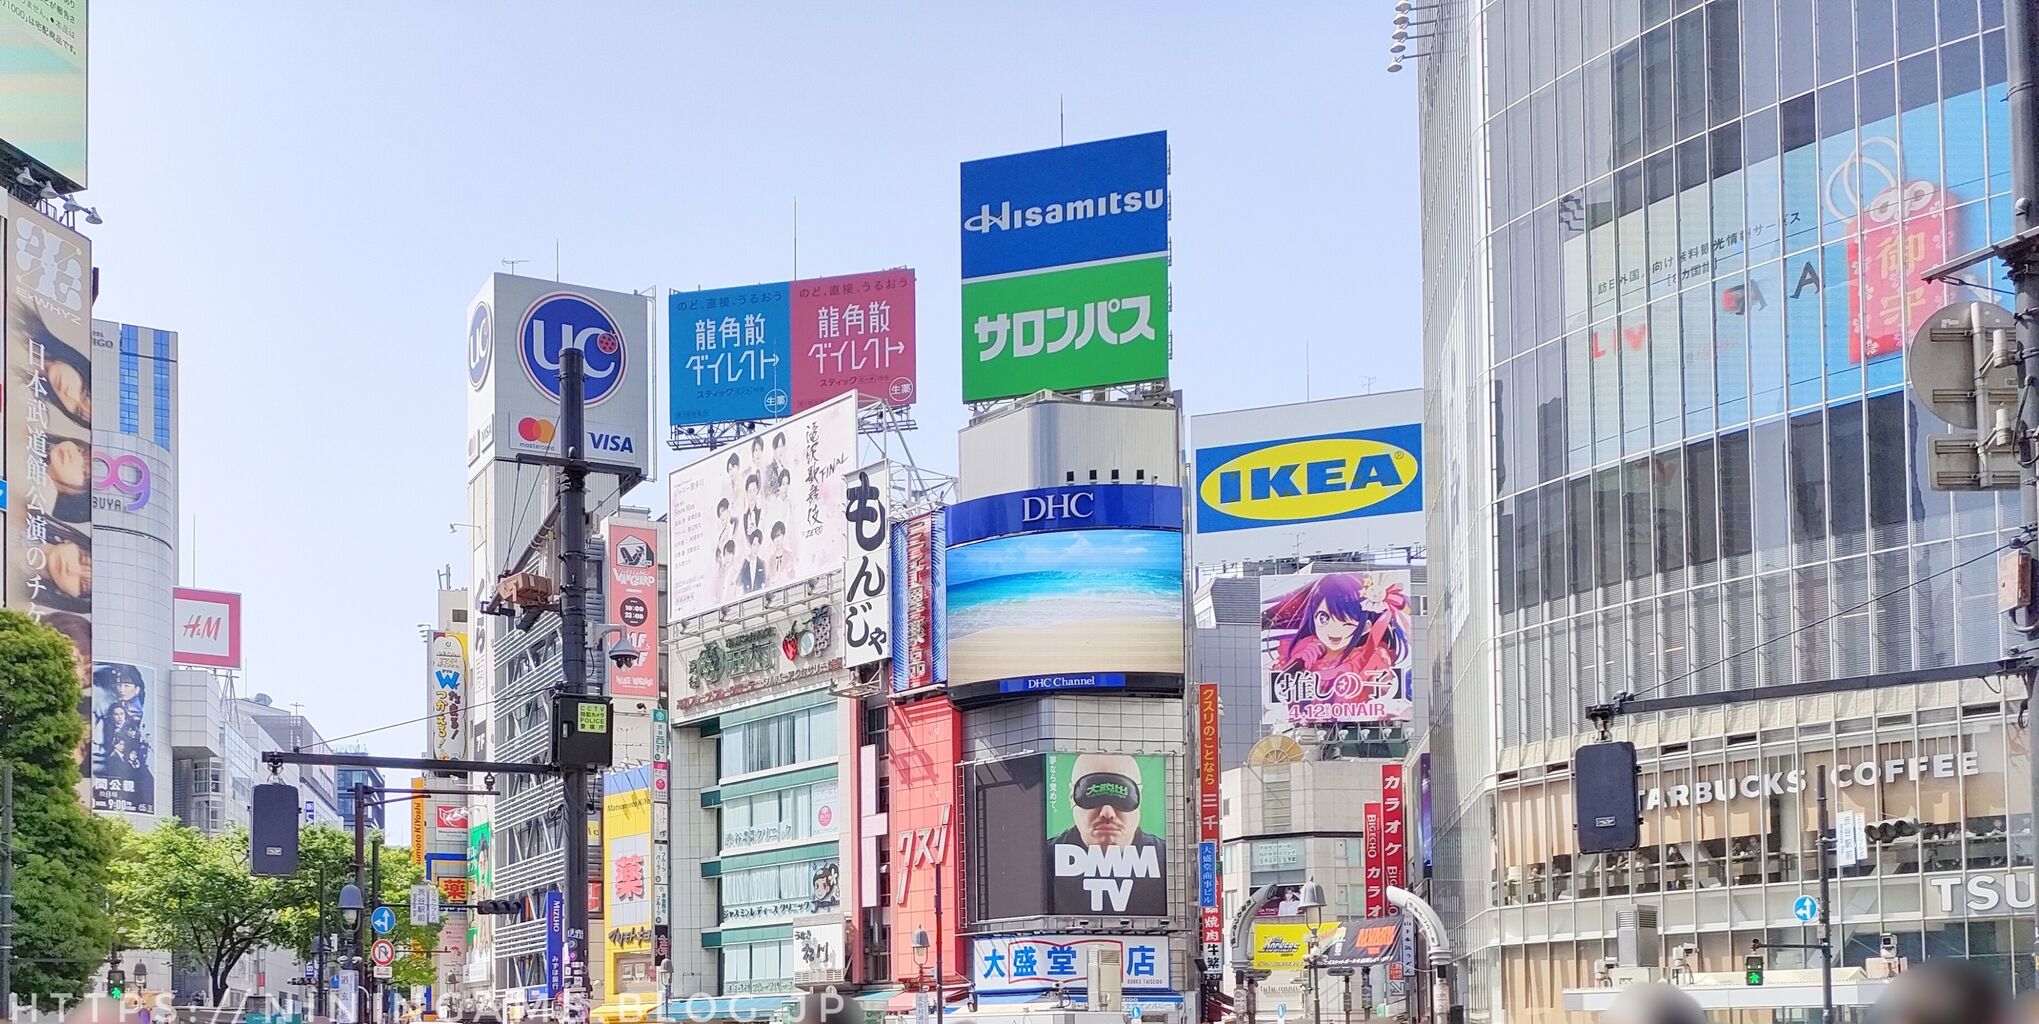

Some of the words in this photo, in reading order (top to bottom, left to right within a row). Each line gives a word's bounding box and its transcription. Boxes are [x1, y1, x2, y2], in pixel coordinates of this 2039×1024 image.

[964, 188, 1164, 233] Hisamitsu
[695, 312, 766, 352] 龍角散
[817, 300, 891, 339] 龍角散
[974, 295, 1156, 362] サロンパス
[533, 319, 618, 379] UC
[891, 384, 913, 396] 生薬
[587, 432, 634, 453] VISA
[1219, 453, 1404, 505] IKEA
[1022, 492, 1095, 522] DHC
[845, 471, 887, 656] もんじゃ
[183, 614, 222, 641] H&M
[1028, 677, 1051, 688] DHC
[1053, 675, 1095, 686] Channel
[1202, 689, 1216, 785] クスリのことなら
[1638, 770, 1806, 812] TARBUCKS
[1830, 751, 1979, 788] COFFEE
[1384, 775, 1402, 856] カラオケ
[898, 803, 953, 905] クスリ
[1055, 844, 1161, 878] DMM
[444, 879, 466, 900] 薬
[615, 855, 644, 900] 薬
[1083, 879, 1133, 912] TV
[723, 901, 811, 919] ジャスミンレディースクリニック
[984, 945, 1156, 979] 大盛堂店
[1207, 944, 1220, 969] 牛繁
